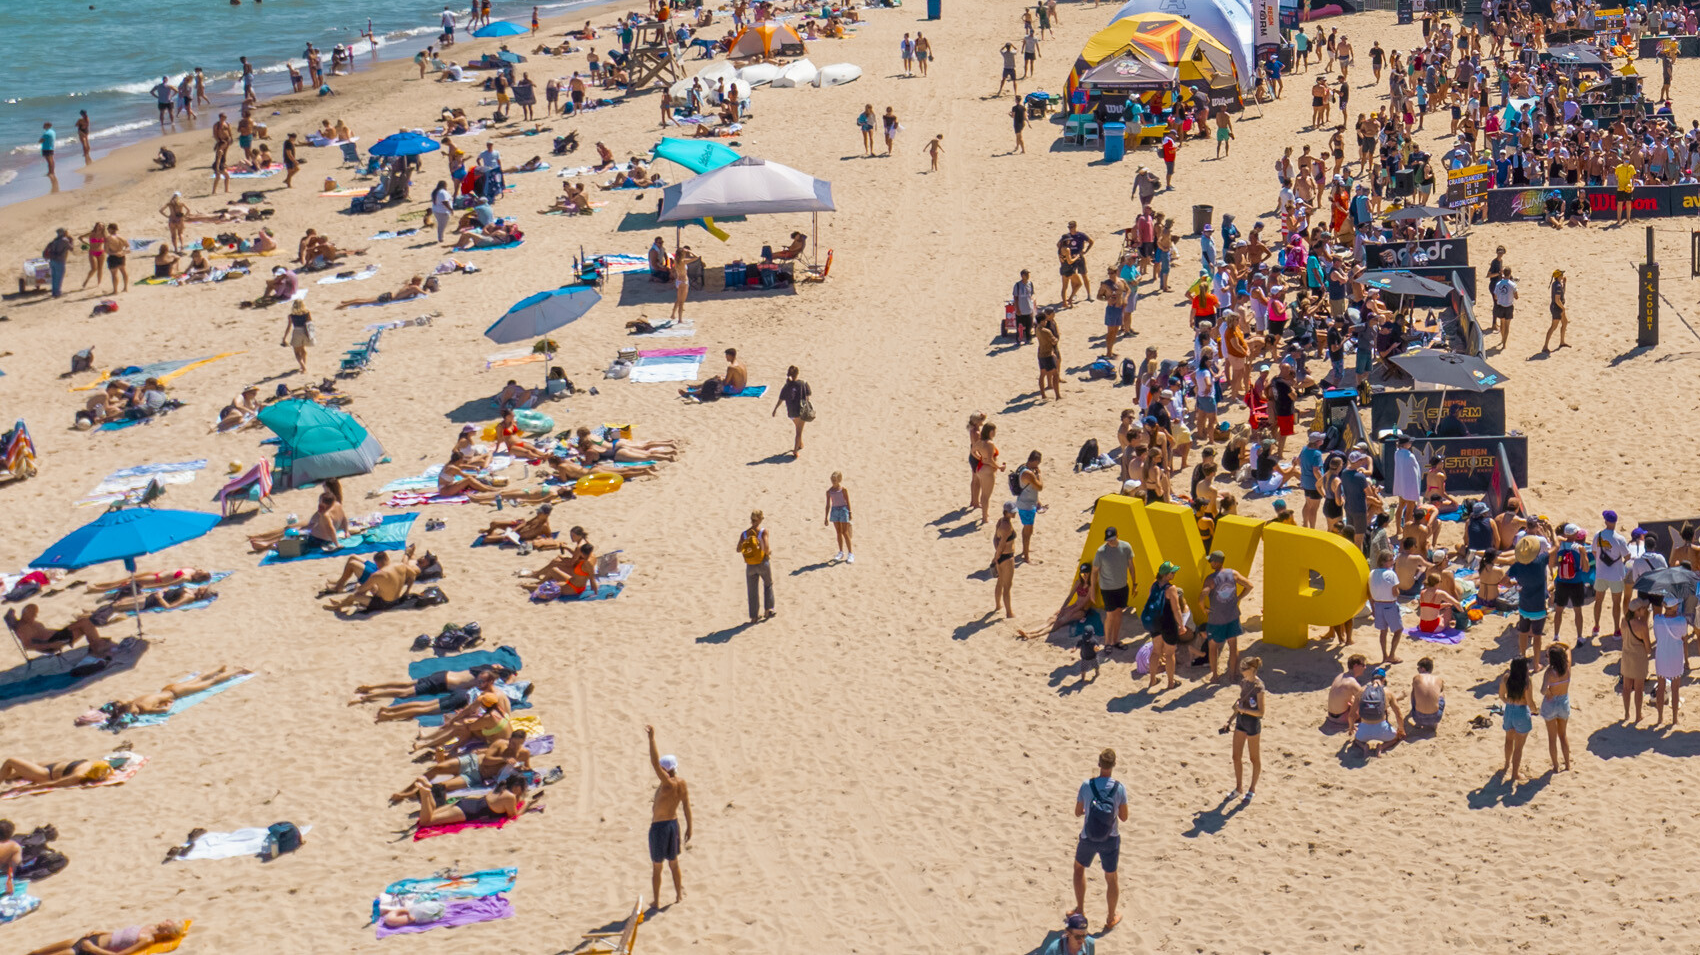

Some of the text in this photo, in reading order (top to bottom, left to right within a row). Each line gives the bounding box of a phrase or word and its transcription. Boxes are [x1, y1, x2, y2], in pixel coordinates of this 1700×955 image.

[1511, 189, 1554, 217] SLUNK
[1588, 194, 1658, 211] Wion
[1646, 271, 1653, 279] 2
[1426, 406, 1482, 419] STRM
[1460, 448, 1488, 456] REIGN
[1444, 456, 1496, 468] STOR
[1070, 494, 1371, 650] AVP
